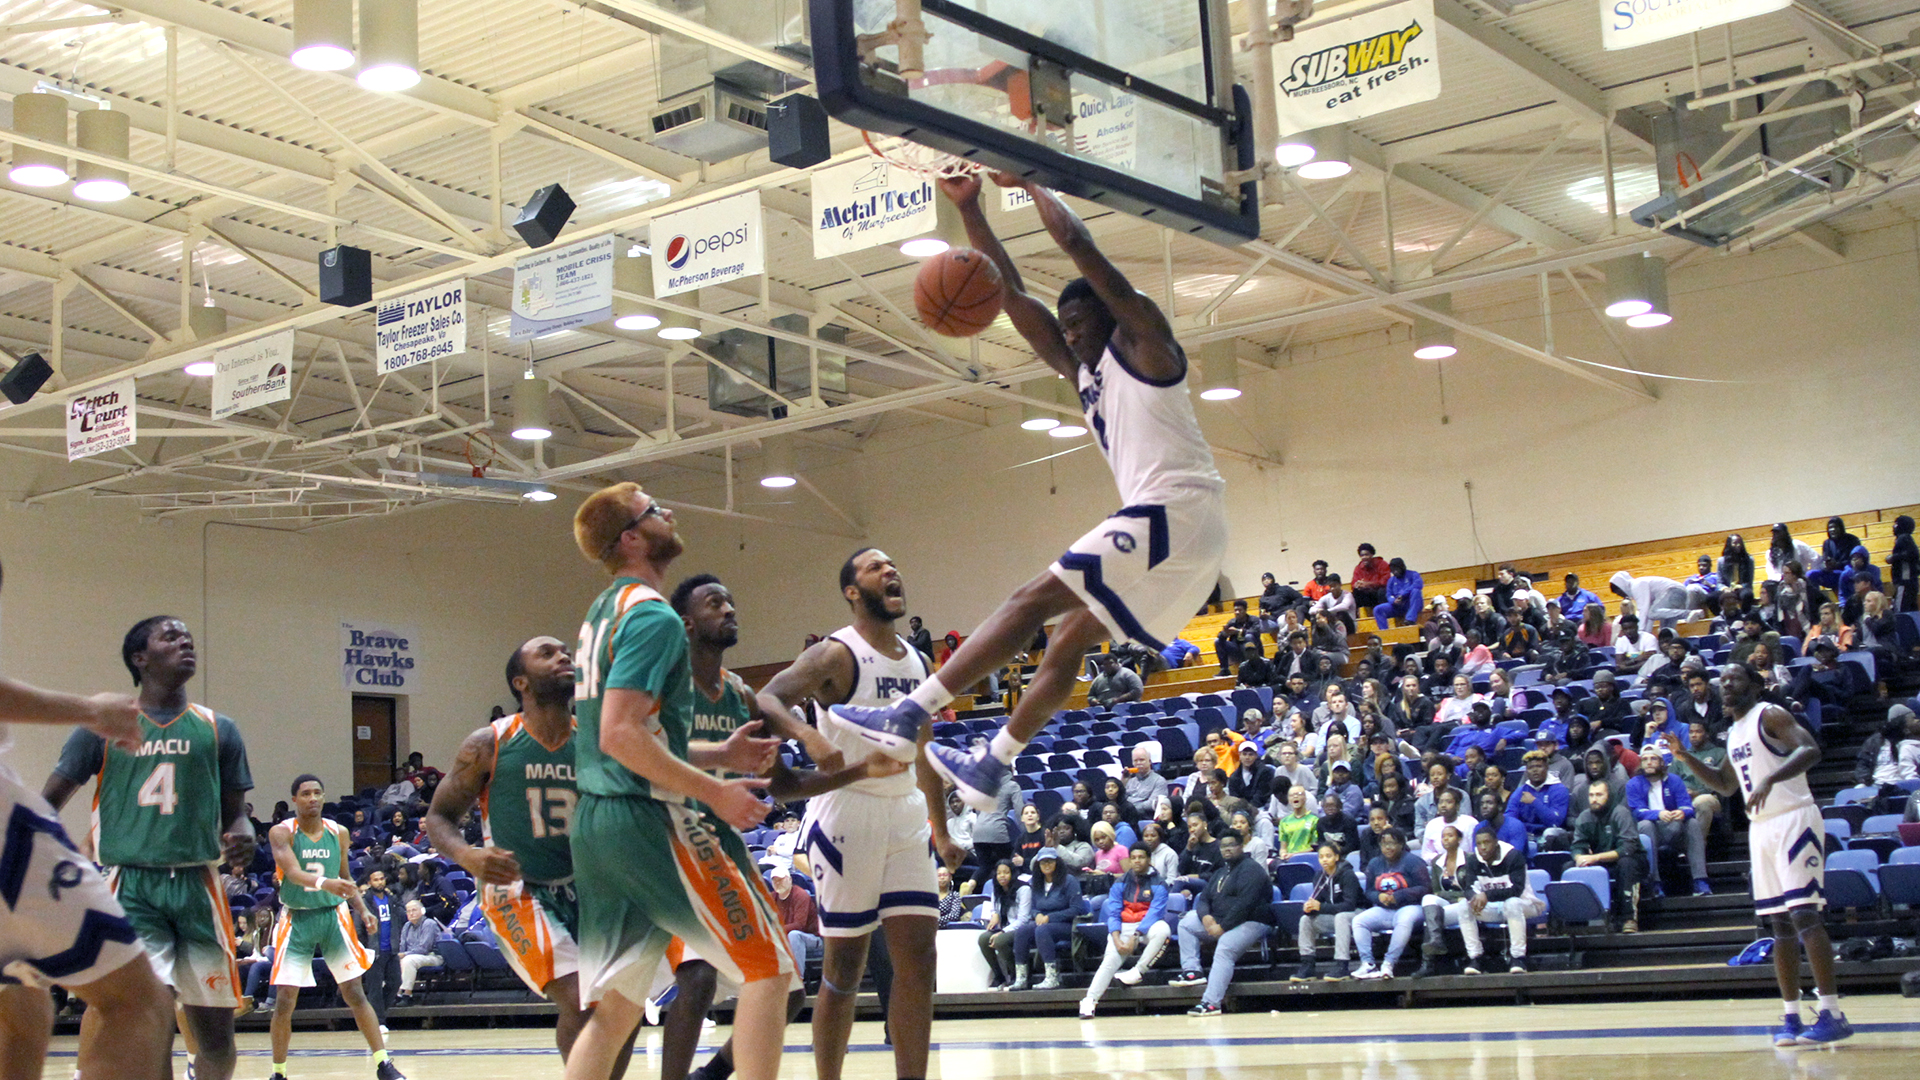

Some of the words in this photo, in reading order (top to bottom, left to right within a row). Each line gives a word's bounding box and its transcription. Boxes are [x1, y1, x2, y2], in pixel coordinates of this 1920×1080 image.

[1280, 19, 1423, 97] SUBWAY
[1326, 86, 1362, 109] eat
[1367, 56, 1429, 91] fresh.
[1080, 99, 1108, 118] Quick
[1110, 94, 1134, 110] Lane
[1125, 107, 1134, 118] of
[1096, 120, 1134, 138] Ahoskie
[820, 195, 876, 230] Metal
[881, 181, 932, 213] Tech
[842, 225, 854, 240] Of
[857, 204, 927, 233] Murfreesboro
[694, 222, 747, 260] pepsi
[556, 260, 584, 274] MOBILE
[585, 252, 612, 266] CRISIS
[556, 270, 577, 282] TEAM
[668, 271, 709, 289] McPherson
[711, 262, 745, 279] Beverage
[407, 289, 461, 318] TAYLOR
[377, 328, 399, 348] Taylor
[402, 322, 429, 340] Freezer
[430, 314, 450, 332] Sales
[452, 309, 464, 325] Co.
[217, 362, 230, 373] Our
[231, 354, 256, 369] Interest
[384, 340, 453, 370] 1800-768-6945
[232, 376, 287, 400] SouthernBank
[71, 391, 119, 420] Stitch
[349, 630, 409, 651] Brave
[344, 648, 415, 669] Hawks
[356, 668, 405, 687] Club
[876, 677, 921, 698] HAWK
[695, 714, 737, 732] MACU
[135, 739, 190, 757] MACU
[138, 762, 178, 815] 4
[1741, 764, 1753, 792] 5
[526, 787, 578, 839] 13
[302, 849, 330, 859] MACU
